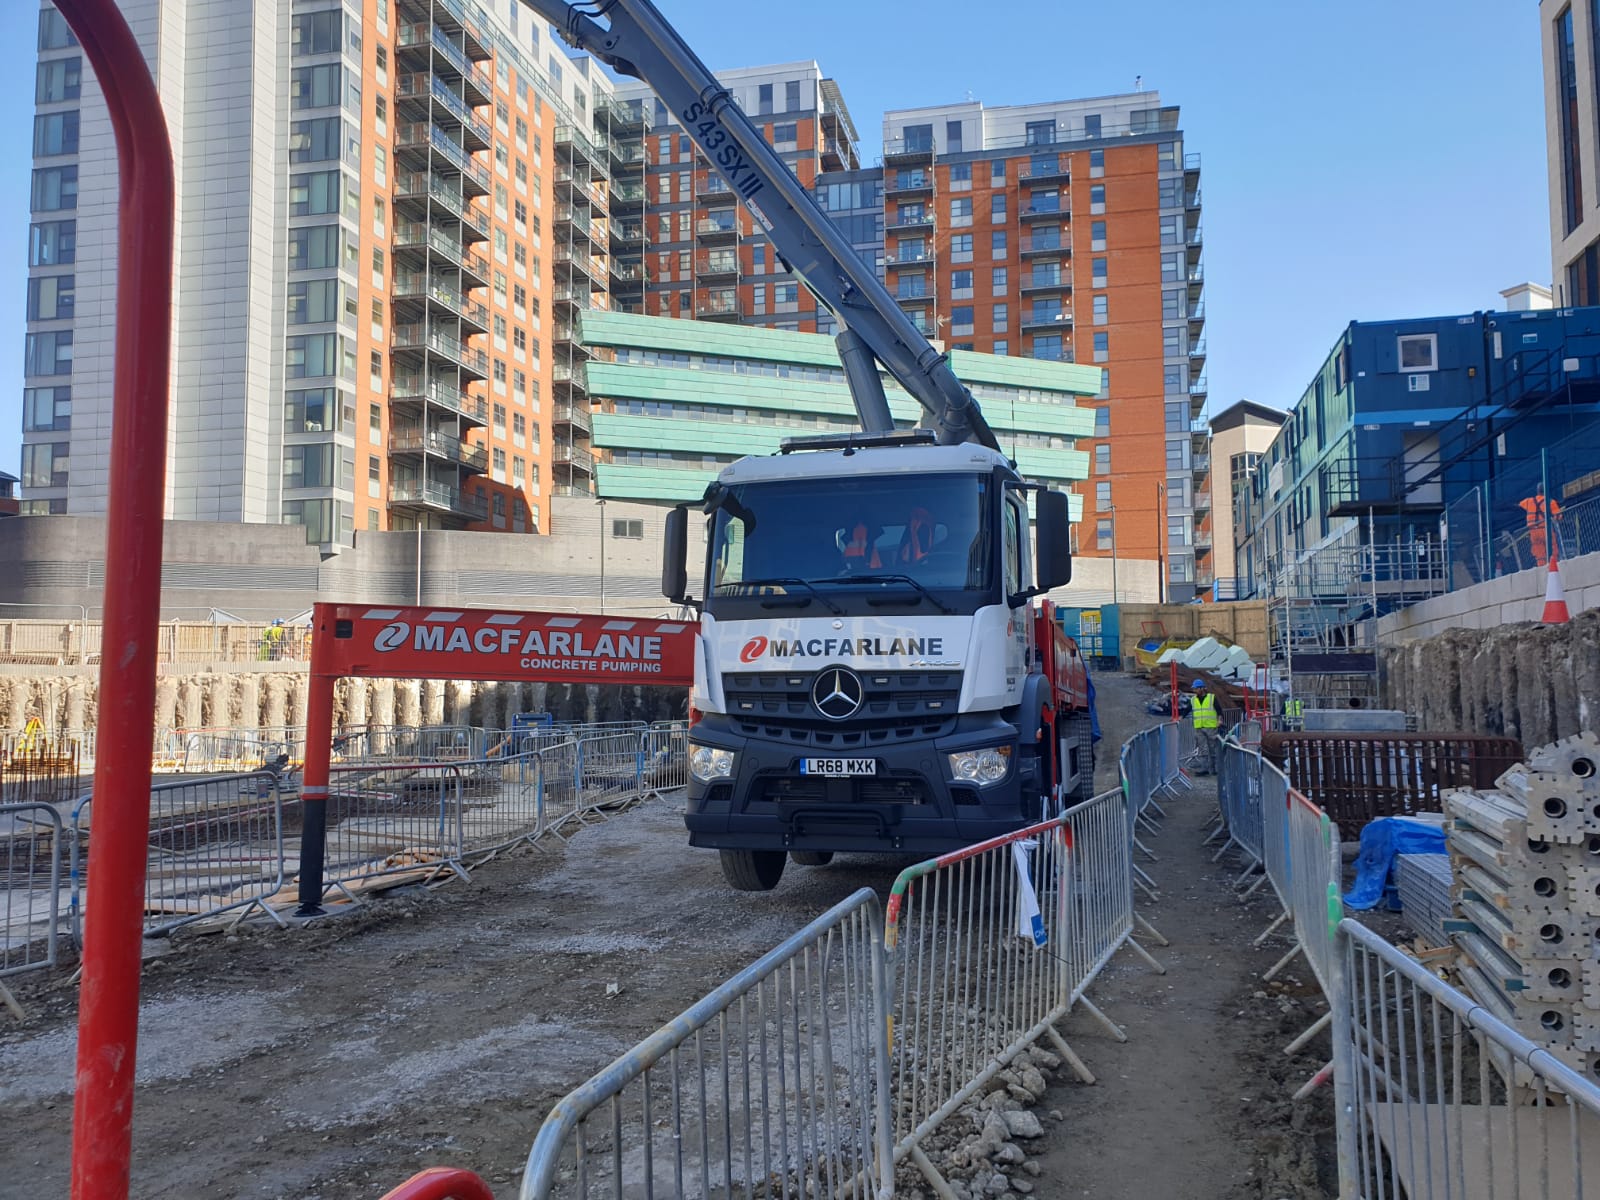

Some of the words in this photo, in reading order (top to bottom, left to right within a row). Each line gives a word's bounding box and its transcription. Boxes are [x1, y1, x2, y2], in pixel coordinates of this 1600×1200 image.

[683, 102, 704, 123] S
[697, 121, 726, 150] 43
[717, 144, 750, 180] SX
[413, 625, 663, 661] MACFARLANE
[769, 637, 943, 657] MACFARLANE
[520, 658, 597, 671] CONCRETE
[601, 660, 661, 673] PUMPING
[808, 760, 843, 773] LR68
[847, 760, 873, 773] MXK
